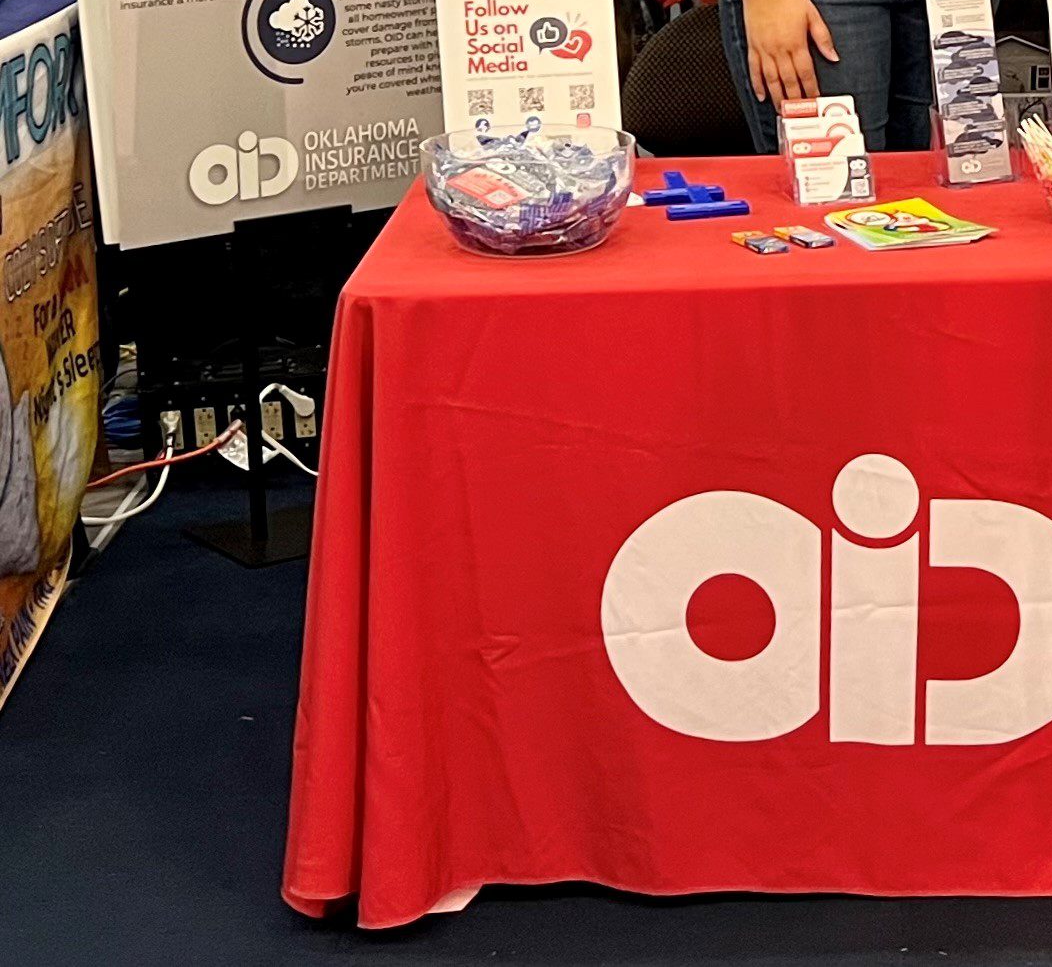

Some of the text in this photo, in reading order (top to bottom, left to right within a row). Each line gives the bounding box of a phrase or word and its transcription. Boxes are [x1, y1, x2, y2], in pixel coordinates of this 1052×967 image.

[464, 0, 529, 17] Follow
[466, 20, 518, 36] Us on
[467, 36, 524, 55] Social
[468, 56, 528, 74] Media
[304, 118, 419, 151] OKLAHOMA
[305, 138, 419, 172] INSURANCE
[306, 159, 419, 191] DEPARTMENT
